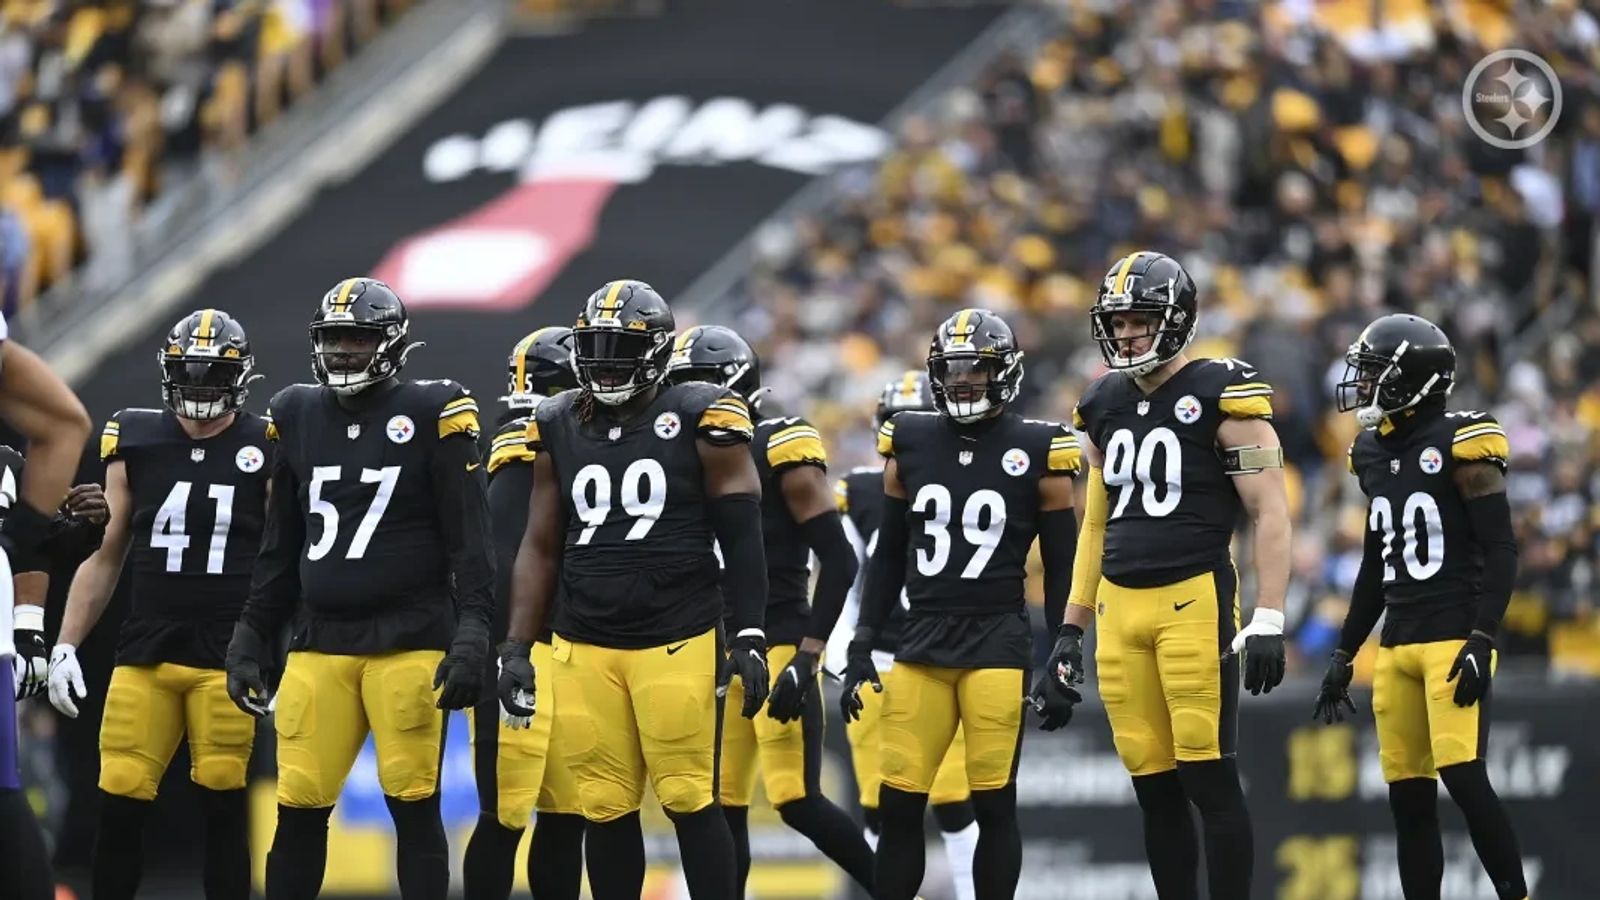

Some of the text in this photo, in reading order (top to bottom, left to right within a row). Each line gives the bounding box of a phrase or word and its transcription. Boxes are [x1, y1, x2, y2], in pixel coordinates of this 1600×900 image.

[307, 465, 402, 561] 57
[571, 458, 667, 545] 99
[1103, 426, 1182, 518] 90
[150, 481, 235, 574] 41
[912, 483, 1007, 579] 39
[1369, 491, 1445, 581] 20
